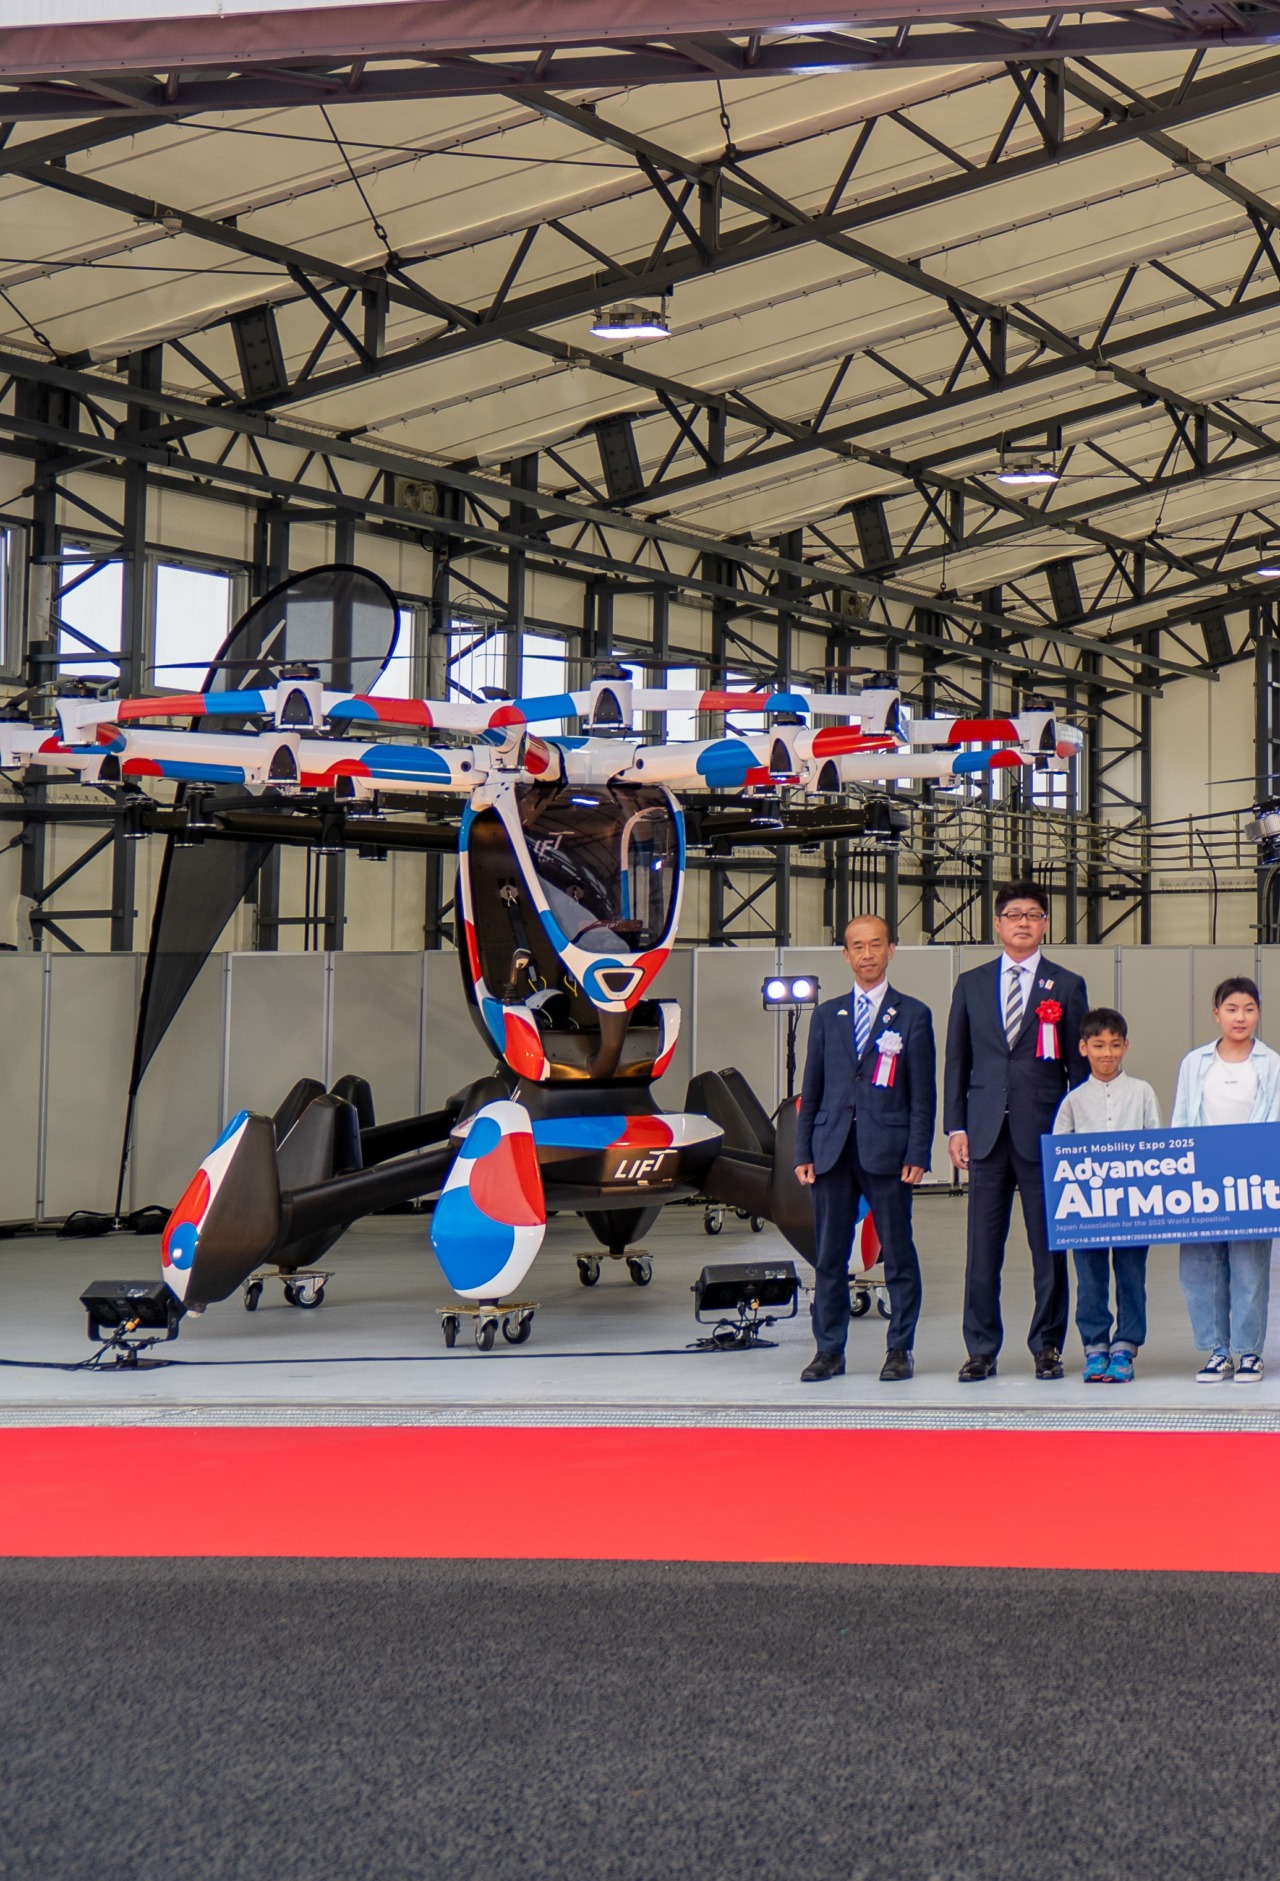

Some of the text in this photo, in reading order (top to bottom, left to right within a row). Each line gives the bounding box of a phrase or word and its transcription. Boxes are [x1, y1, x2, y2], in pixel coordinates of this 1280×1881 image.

[1055, 1138, 1195, 1155] Smart Mobility Expo 2025
[614, 1149, 678, 1179] LIFT
[1053, 1151, 1196, 1182] Advanced
[1055, 1215, 1231, 1232] Japan Association for the 2025 World Exposition
